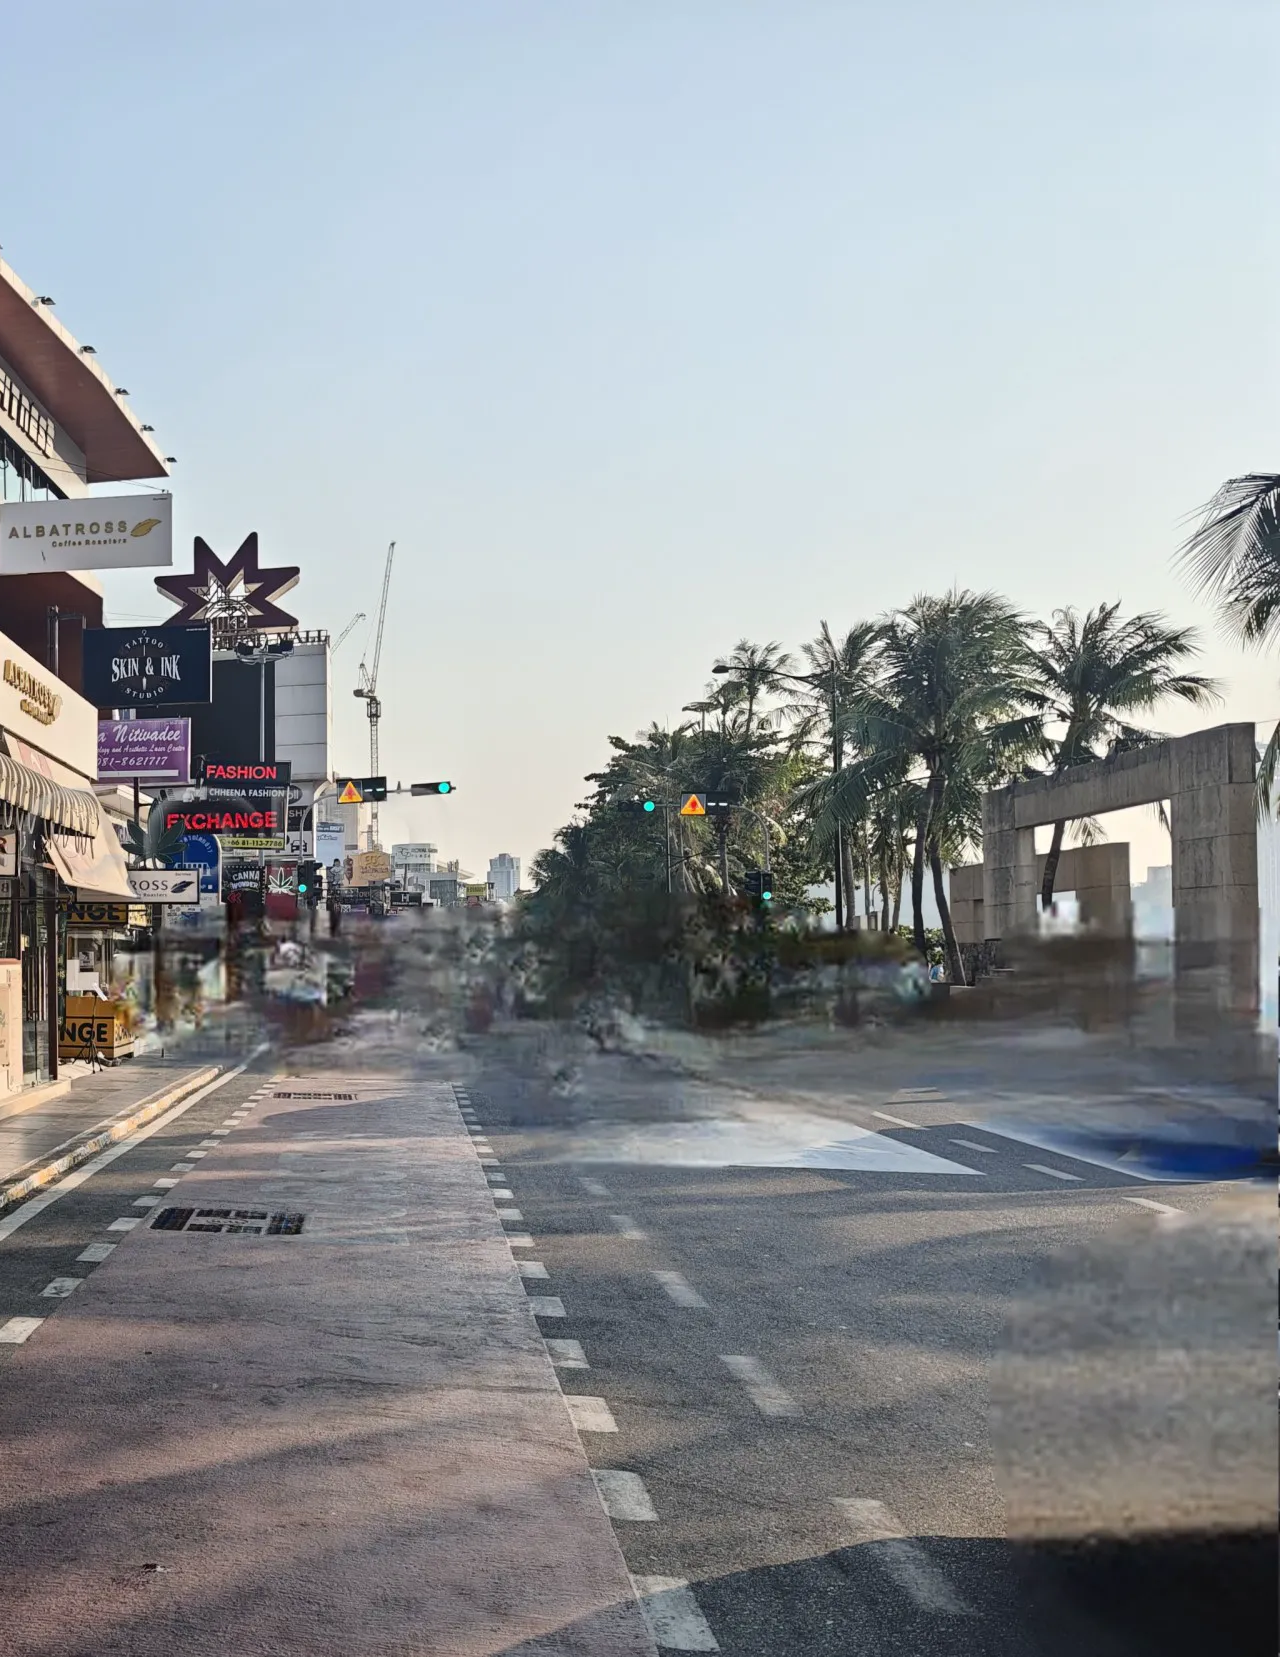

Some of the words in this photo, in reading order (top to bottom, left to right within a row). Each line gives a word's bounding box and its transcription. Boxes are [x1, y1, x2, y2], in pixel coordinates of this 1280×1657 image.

[8, 520, 128, 539] ALBATROSS
[51, 540, 83, 548] Coffee
[84, 538, 128, 546] Roasters
[125, 637, 164, 650] TATTOO
[111, 657, 140, 683] SKIN
[145, 657, 154, 675] &
[161, 655, 181, 680] INK
[124, 686, 164, 699] STUDIO
[206, 765, 277, 780] FASHION
[209, 788, 246, 797] CHHEENA
[248, 788, 285, 798] FASHION
[233, 870, 260, 881] CANNA
